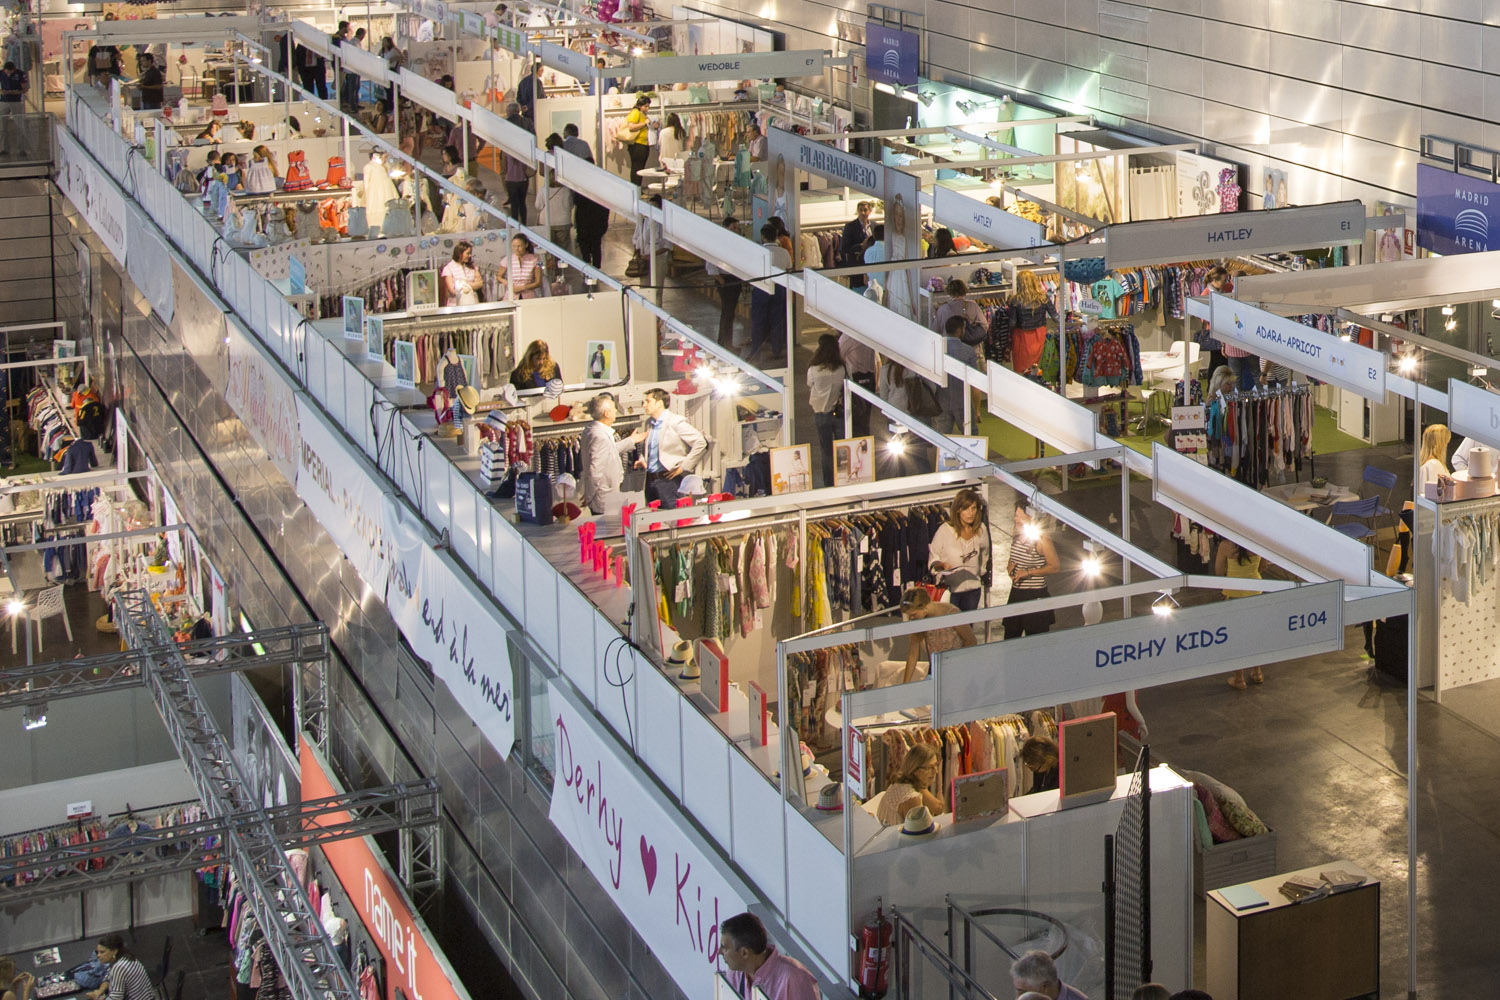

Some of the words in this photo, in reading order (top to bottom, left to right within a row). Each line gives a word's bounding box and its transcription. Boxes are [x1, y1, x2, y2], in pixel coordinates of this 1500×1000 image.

[883, 37, 899, 47] MADRID
[699, 61, 740, 71] WEDOBLE
[805, 58, 814, 66] E7
[884, 69, 899, 80] ARENA
[800, 144, 827, 171] PILAR
[1455, 188, 1489, 206] MADRID
[973, 212, 993, 229] HATLEY
[1207, 228, 1252, 243] HATLEY
[1340, 220, 1350, 231] E1
[1455, 235, 1488, 252] ARENA
[1081, 301, 1099, 311] Hatley
[1256, 325, 1322, 359] ADARA-APRICOT
[1368, 367, 1377, 380] E2
[1095, 637, 1166, 668] DERHY
[1176, 626, 1229, 653] KIDS
[1288, 611, 1328, 631] E104
[481, 673, 511, 722] mer
[556, 713, 622, 890] Derhy
[675, 852, 722, 972] Kid
[364, 867, 405, 975] name
